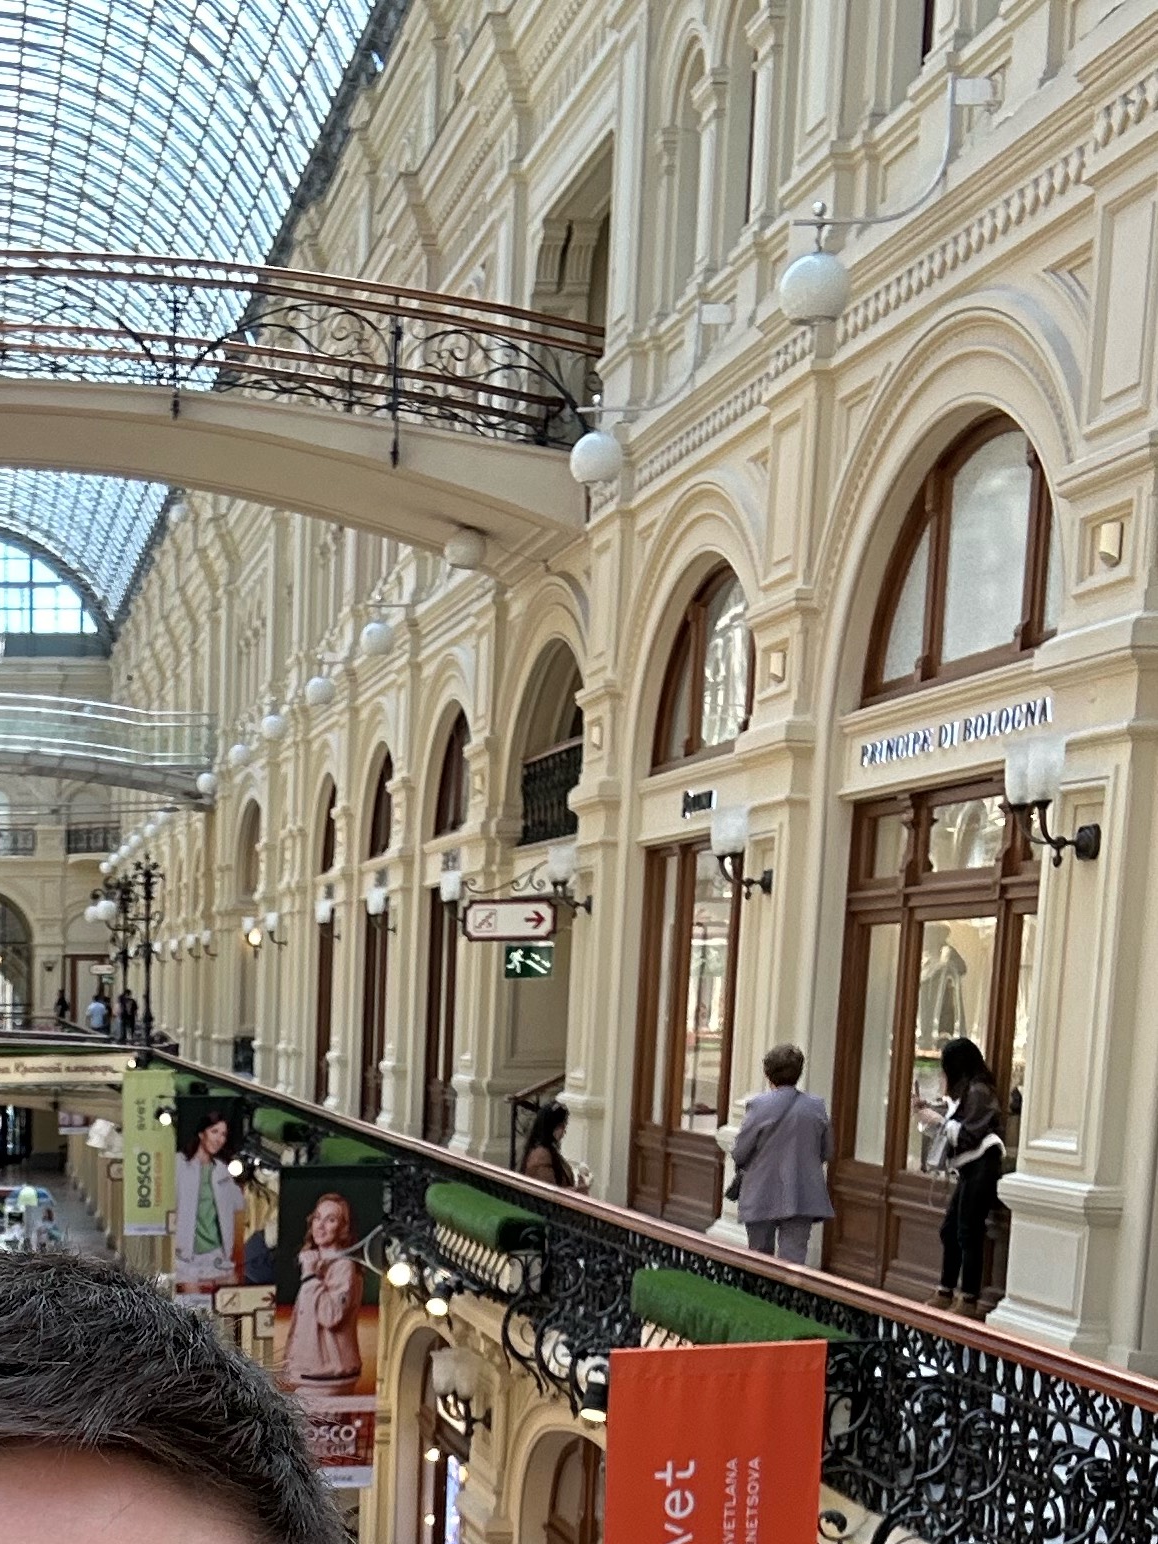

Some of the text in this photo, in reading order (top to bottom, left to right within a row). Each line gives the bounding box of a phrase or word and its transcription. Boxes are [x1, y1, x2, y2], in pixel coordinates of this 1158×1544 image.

[861, 696, 1053, 767] PRINCIPE DI BOLOGNA
[137, 1151, 151, 1209] BOSCO
[303, 1425, 356, 1444] OSCO
